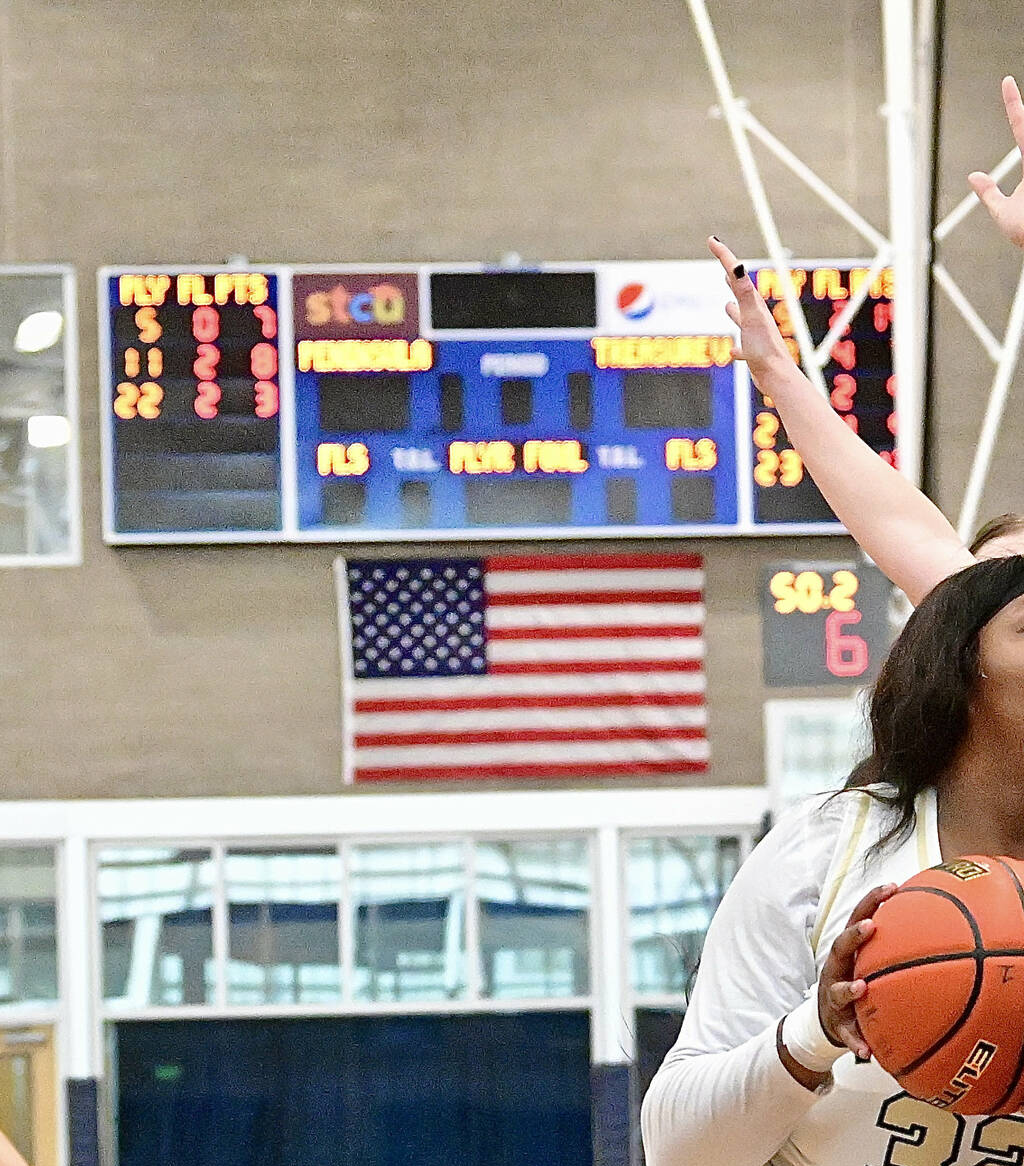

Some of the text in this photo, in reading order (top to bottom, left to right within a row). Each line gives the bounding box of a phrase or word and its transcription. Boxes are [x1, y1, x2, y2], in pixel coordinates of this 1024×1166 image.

[215, 273, 269, 305] PTS
[305, 283, 405, 326] stcu
[135, 306, 163, 343] 5
[192, 305, 220, 343] 0
[124, 347, 163, 378] 11
[193, 343, 220, 381] 2
[113, 380, 279, 420] 22 2 3
[753, 449, 804, 487] 23
[769, 570, 859, 615] 50.2
[825, 609, 868, 677] 6
